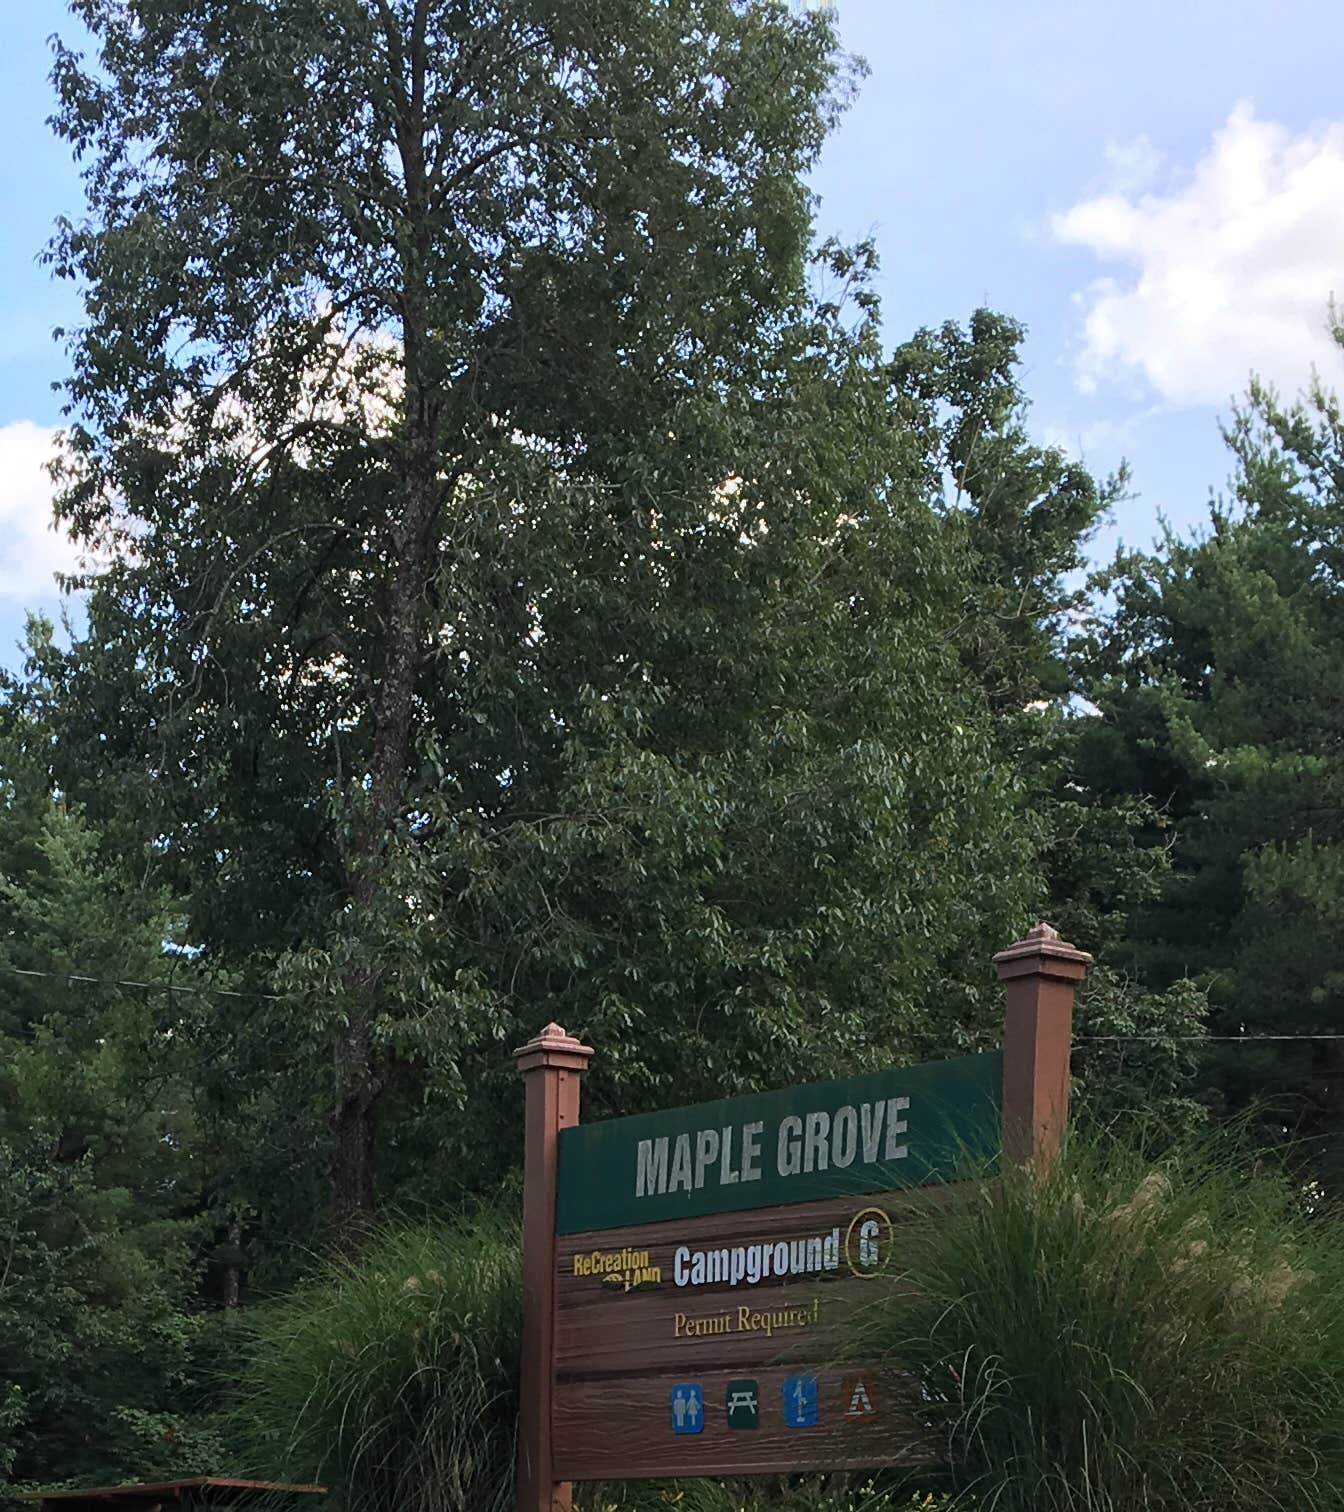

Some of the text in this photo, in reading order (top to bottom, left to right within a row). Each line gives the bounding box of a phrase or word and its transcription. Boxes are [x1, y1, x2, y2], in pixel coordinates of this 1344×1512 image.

[635, 1096, 911, 1198] MAPLE GROVE
[673, 1219, 880, 1288] Campground G
[673, 1298, 820, 1338] Permit Required
